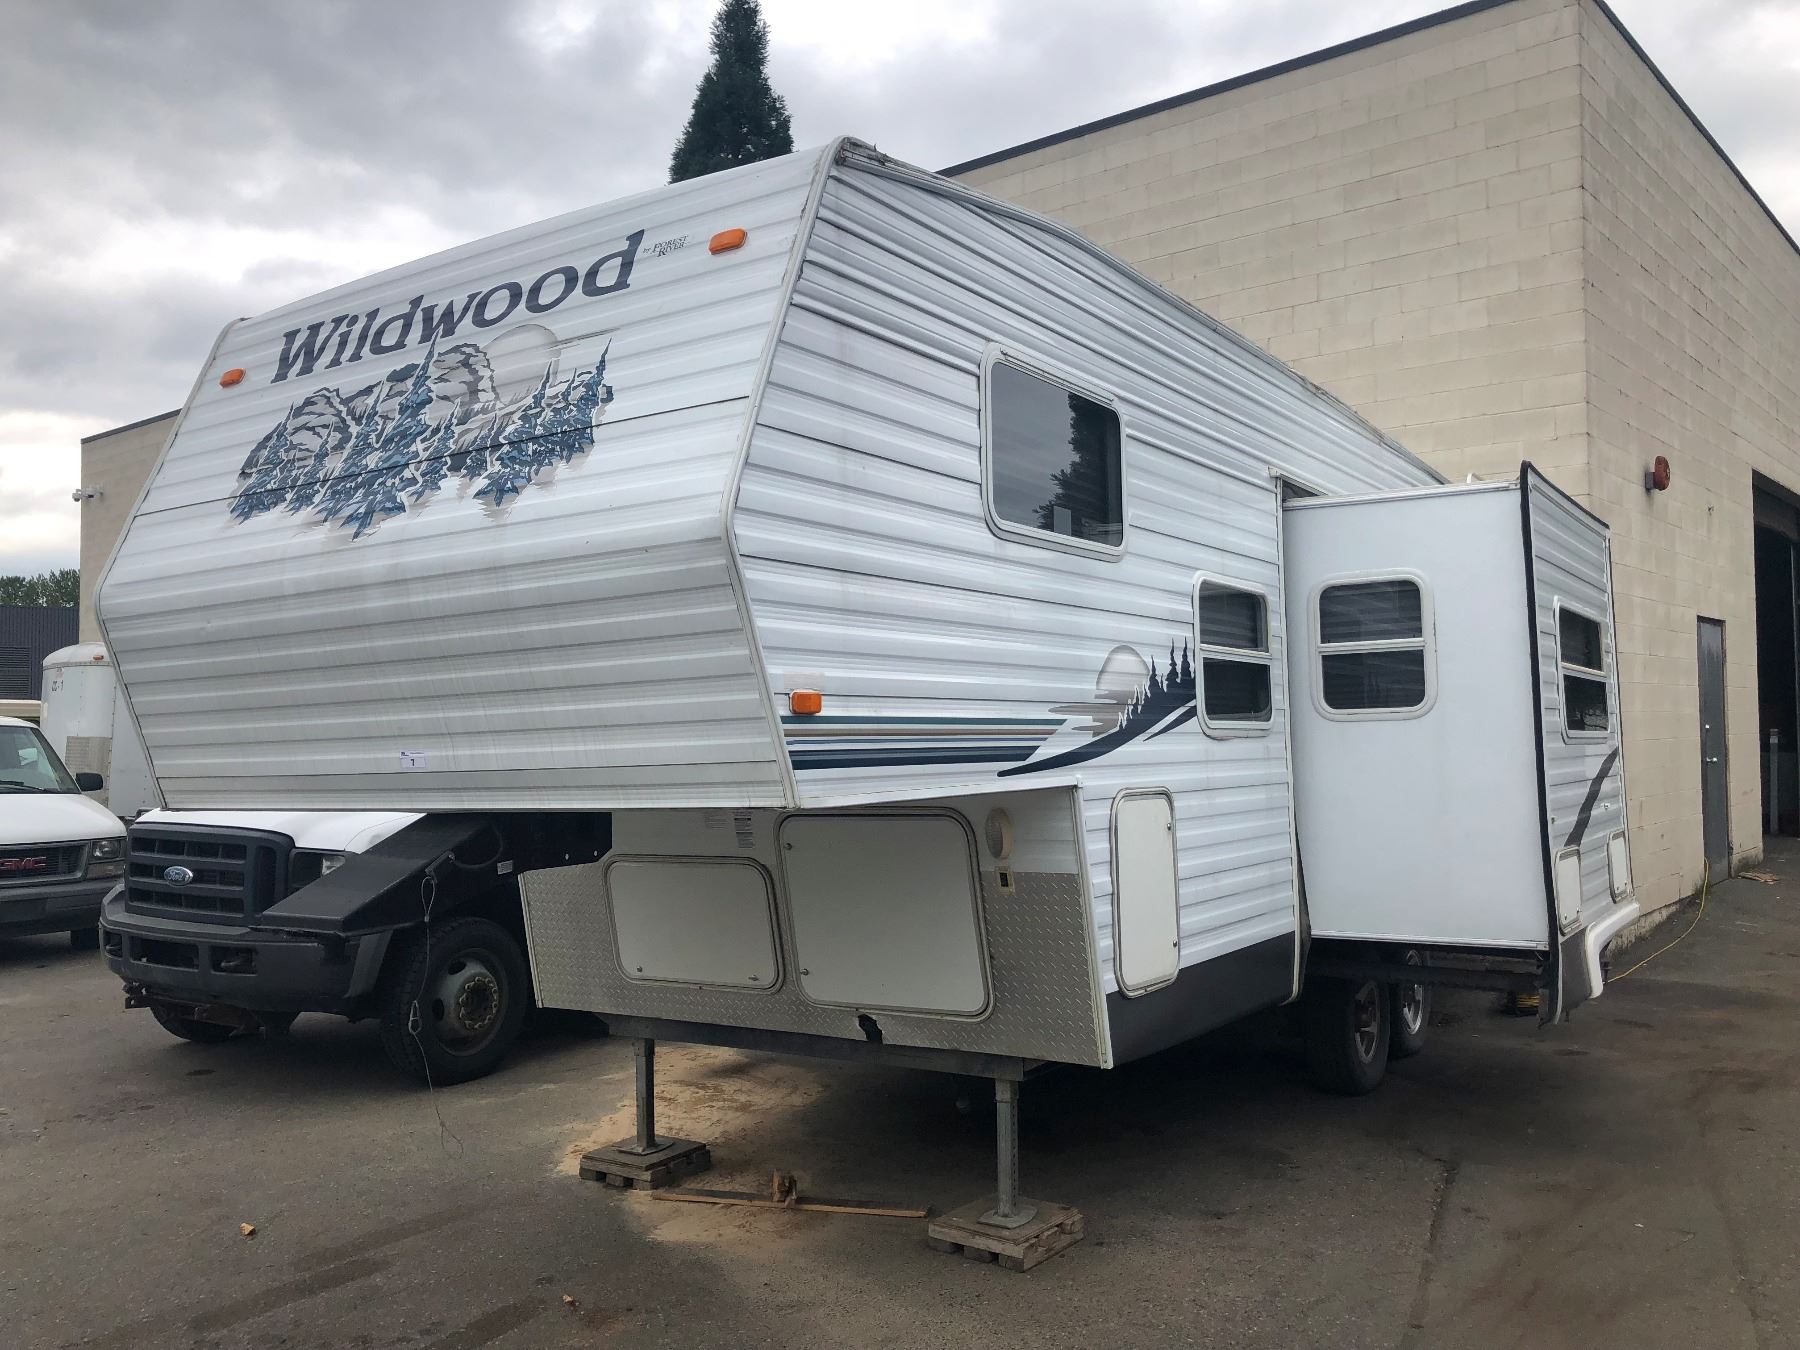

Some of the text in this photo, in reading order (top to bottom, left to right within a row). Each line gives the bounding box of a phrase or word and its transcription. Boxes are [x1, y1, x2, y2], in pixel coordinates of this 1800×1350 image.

[652, 234, 689, 254] FOREST
[656, 241, 688, 258] RIVER
[270, 229, 645, 384] Wildwood
[0, 856, 47, 870] GMC
